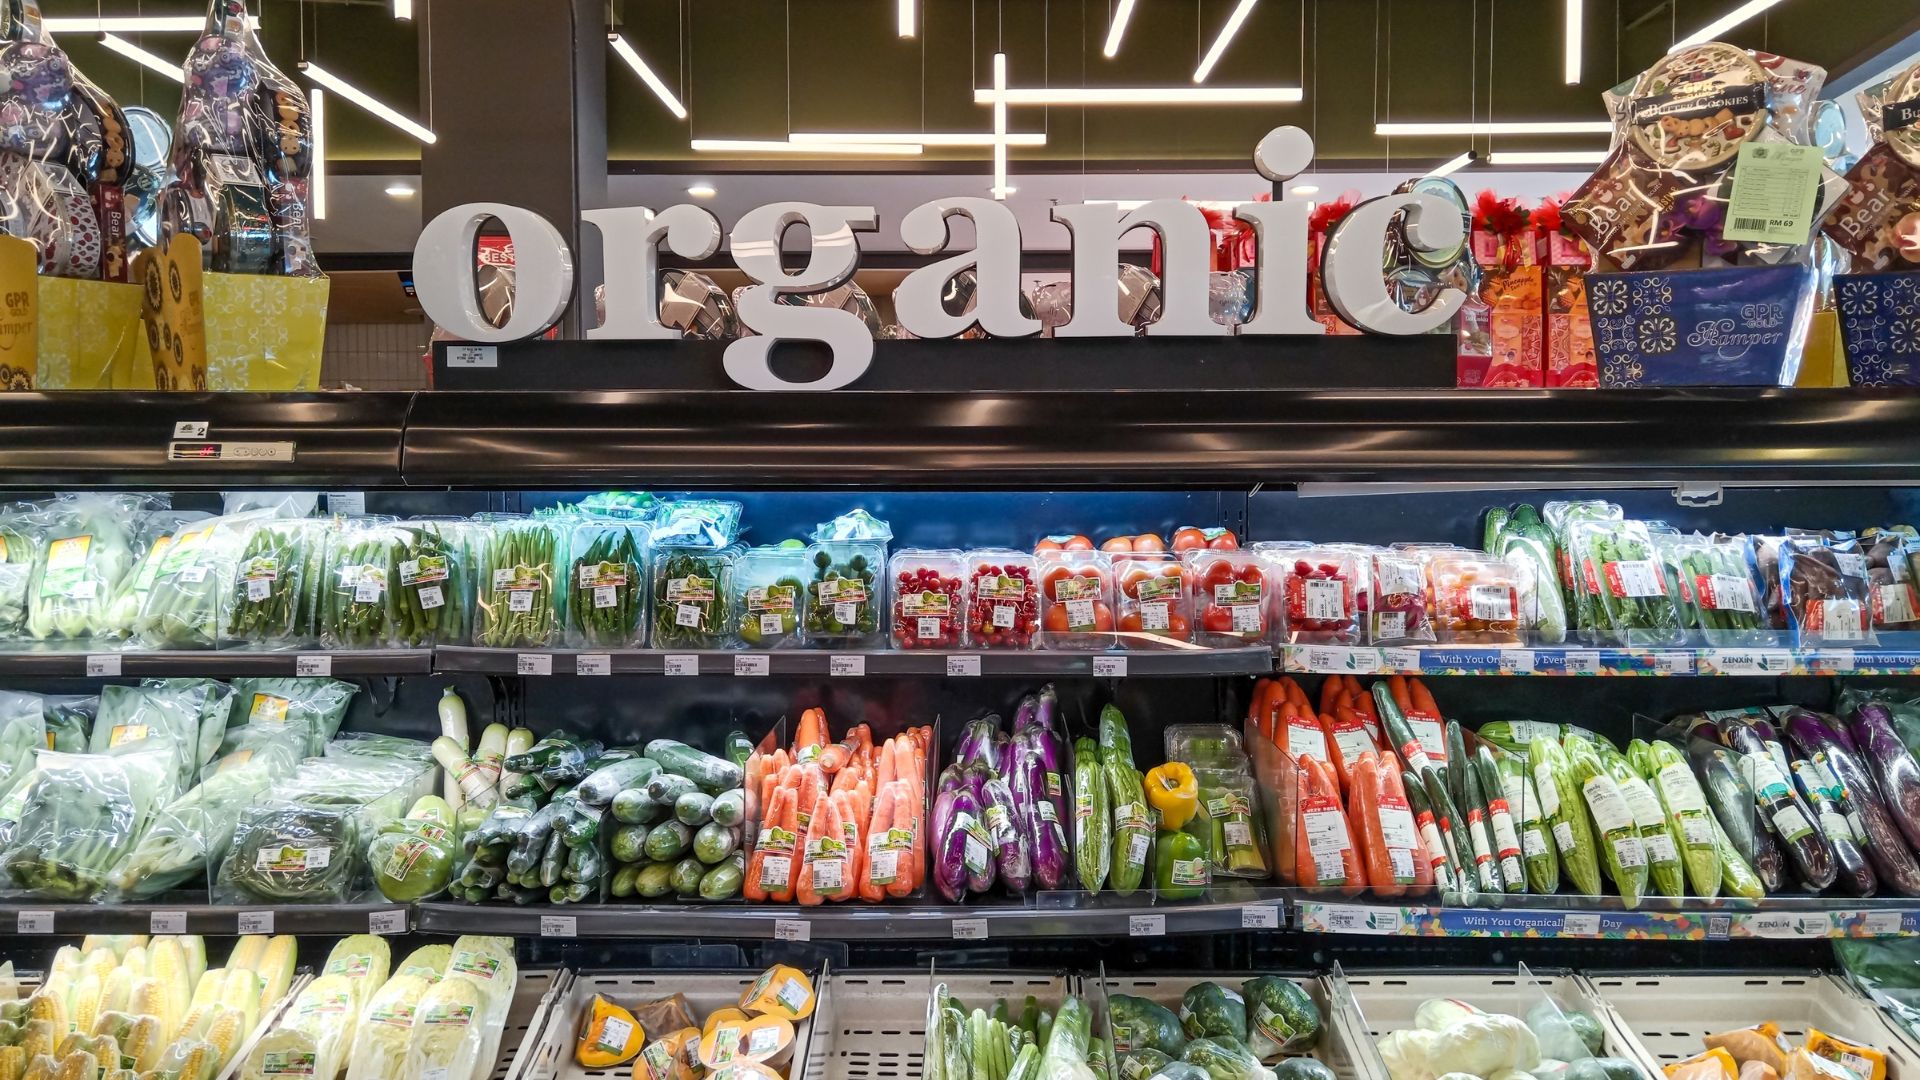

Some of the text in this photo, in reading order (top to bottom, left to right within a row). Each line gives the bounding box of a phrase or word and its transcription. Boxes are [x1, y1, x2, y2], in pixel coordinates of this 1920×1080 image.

[1696, 95, 1749, 110] COOKIES
[1588, 187, 1638, 236] Bear
[1839, 187, 1890, 237] Bear
[111, 211, 122, 238] Bear
[412, 125, 1470, 392] organic
[5, 291, 30, 308] GPR
[1740, 303, 1784, 321] GPR
[1686, 318, 1784, 361] Hamper
[197, 427, 205, 436] 2
[1439, 654, 1463, 664] With
[1465, 655, 1484, 664] You
[1877, 655, 1896, 664] You
[1463, 917, 1623, 929] With You Organicall Day
[1901, 917, 1917, 926] ith
